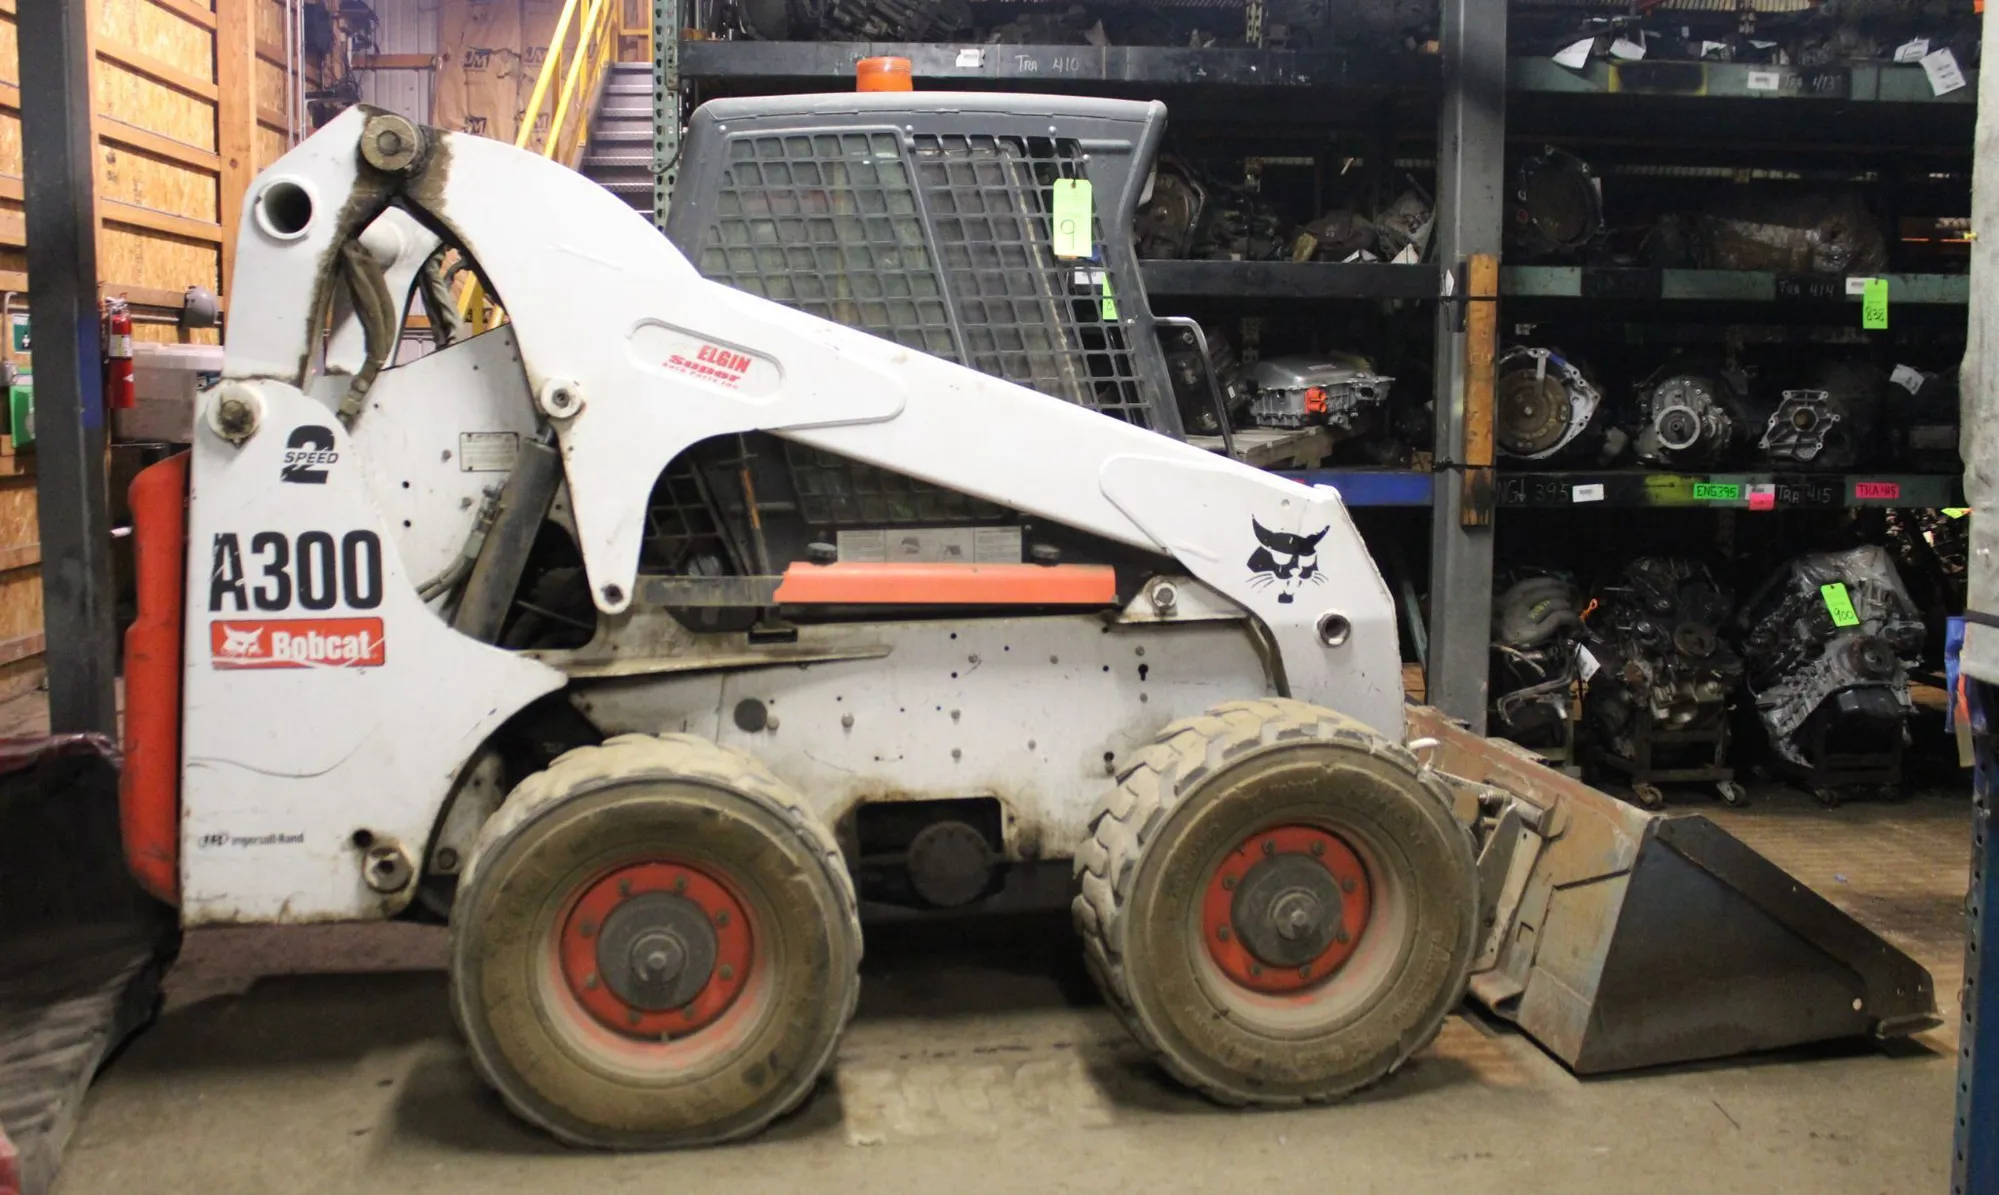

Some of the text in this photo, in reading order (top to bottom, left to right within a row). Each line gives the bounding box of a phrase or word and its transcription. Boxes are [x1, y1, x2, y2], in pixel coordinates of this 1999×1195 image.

[1052, 55, 1080, 73] 410
[1060, 219, 1076, 251] 9
[697, 344, 752, 374] ELGIN
[281, 424, 335, 485] 2
[283, 451, 340, 465] SPEED
[208, 529, 383, 612] A300
[271, 628, 371, 660] Bobcat
